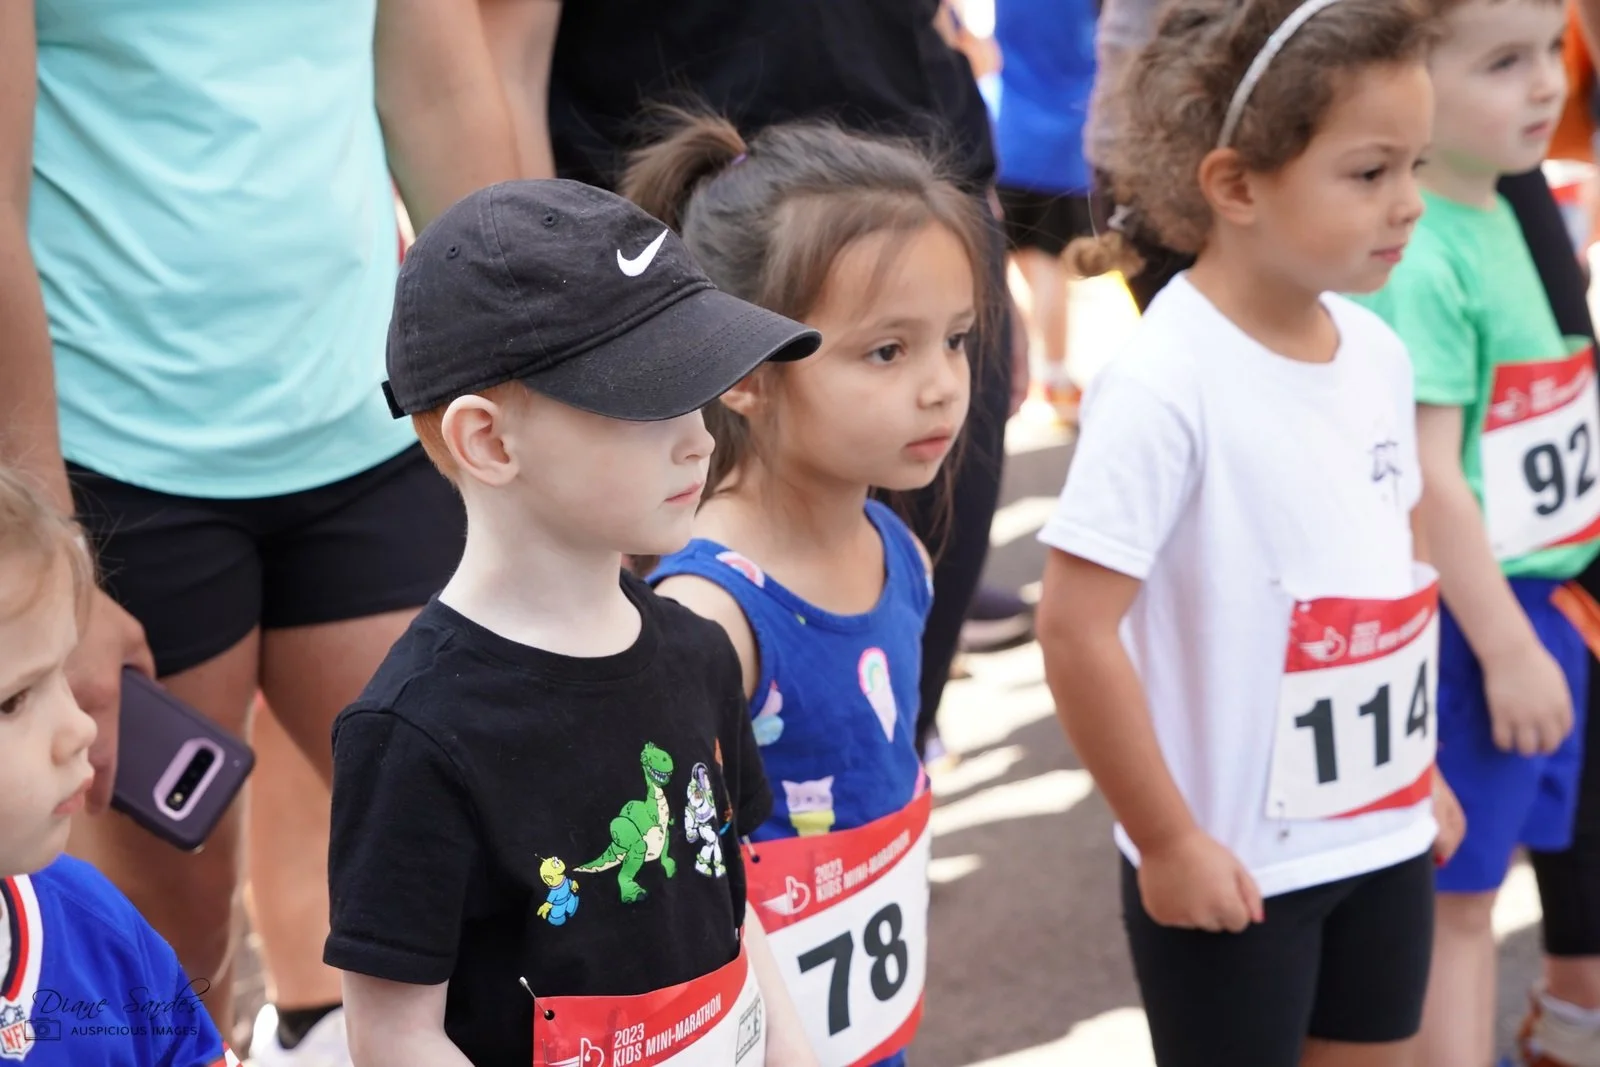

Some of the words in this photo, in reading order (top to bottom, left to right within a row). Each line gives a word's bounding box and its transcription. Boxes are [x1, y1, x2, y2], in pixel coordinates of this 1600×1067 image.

[1523, 423, 1595, 515] 92
[1294, 659, 1428, 784] 114
[797, 902, 908, 1036] 78
[613, 1042, 642, 1067] KIDS
[645, 993, 722, 1057] MINI-MARATHON
[614, 1022, 645, 1048] 2023
